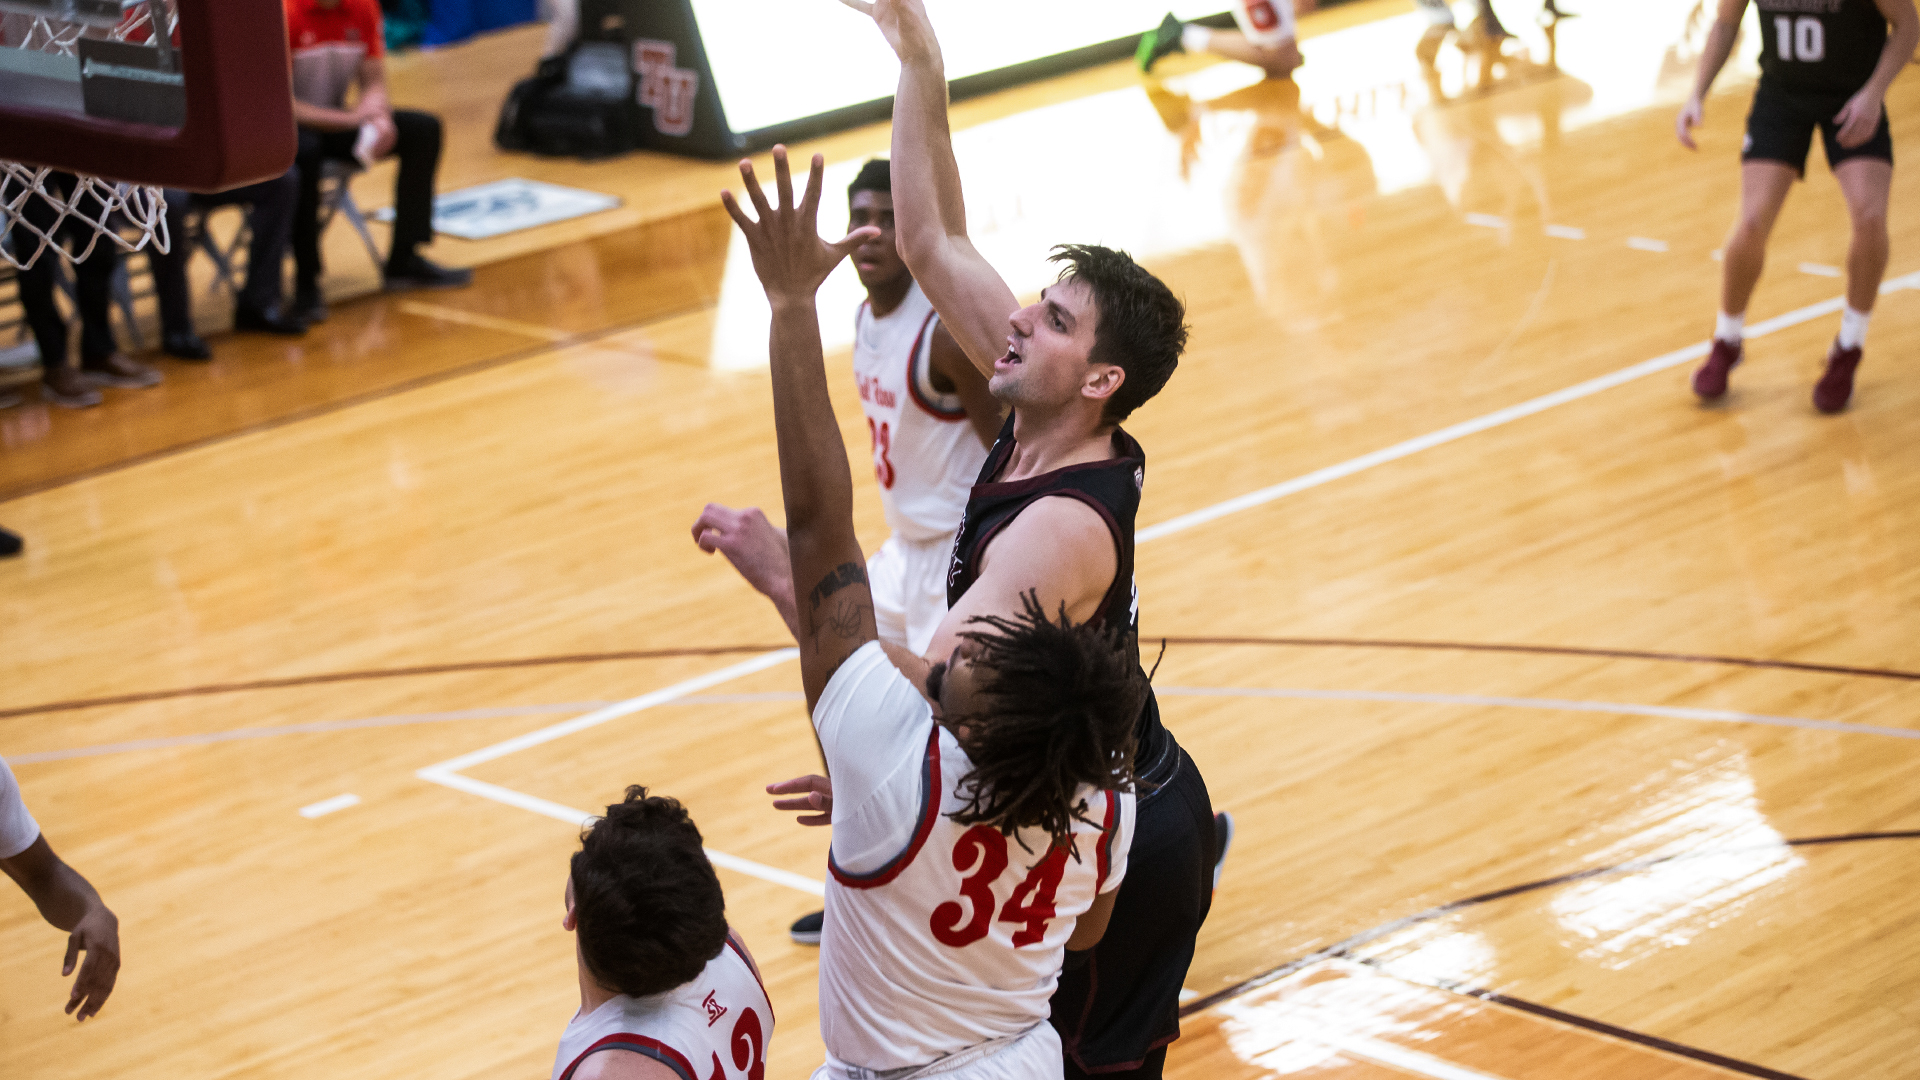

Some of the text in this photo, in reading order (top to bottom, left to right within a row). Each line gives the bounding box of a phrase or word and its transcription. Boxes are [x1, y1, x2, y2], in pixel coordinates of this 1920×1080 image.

[1773, 14, 1825, 61] 10
[632, 38, 698, 136] TU
[929, 824, 1077, 949] 34
